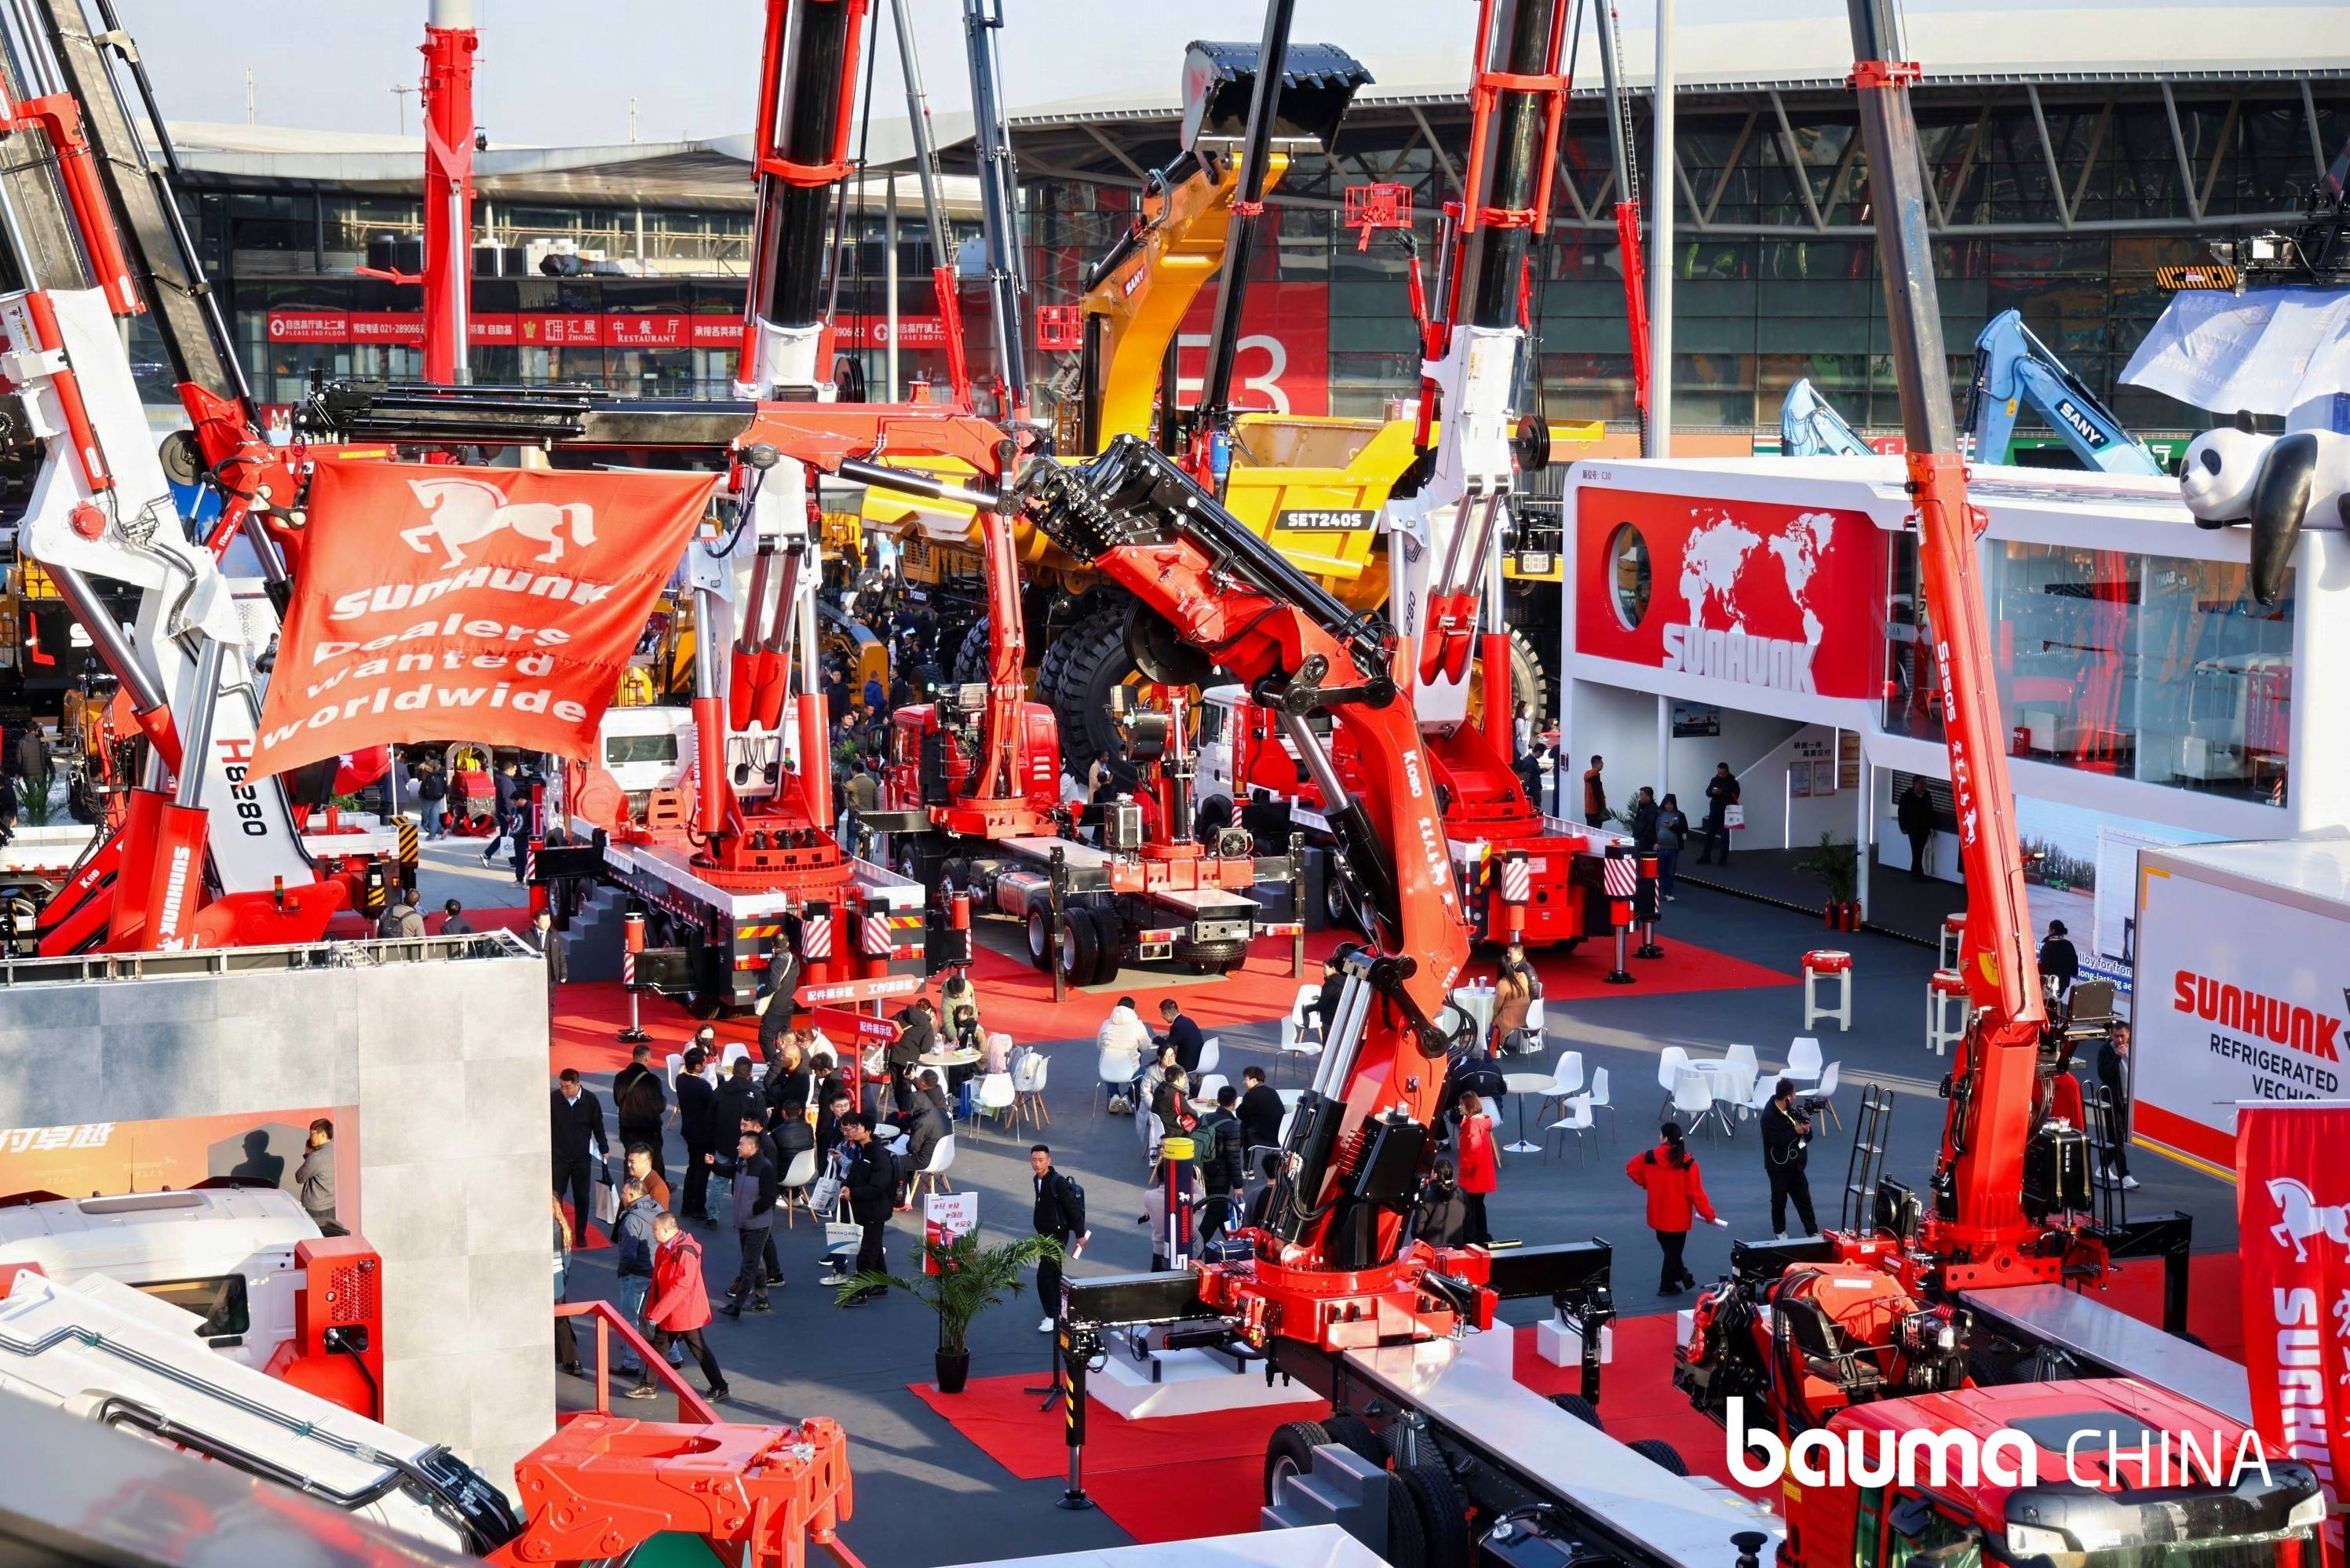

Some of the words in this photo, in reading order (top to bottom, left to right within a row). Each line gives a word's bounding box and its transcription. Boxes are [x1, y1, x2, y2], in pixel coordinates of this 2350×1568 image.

[1126, 267, 1144, 296] SANY
[2060, 402, 2101, 443] SANY
[1287, 513, 1362, 527] SET240S
[329, 566, 616, 622] SUNHUNK
[313, 614, 571, 666] Dealers
[1662, 622, 1818, 695] SUNHUNK
[307, 649, 554, 698] wanted
[261, 682, 587, 751] worldwide
[160, 846, 191, 935] SUNHUNK
[2078, 952, 2096, 968] lloy
[2098, 957, 2111, 970] for
[2113, 961, 2133, 978] fron
[859, 1021, 892, 1037] 配件展示区
[2174, 969, 2342, 1064] SUNHUNK
[2210, 1033, 2339, 1093] REFRIGERATED
